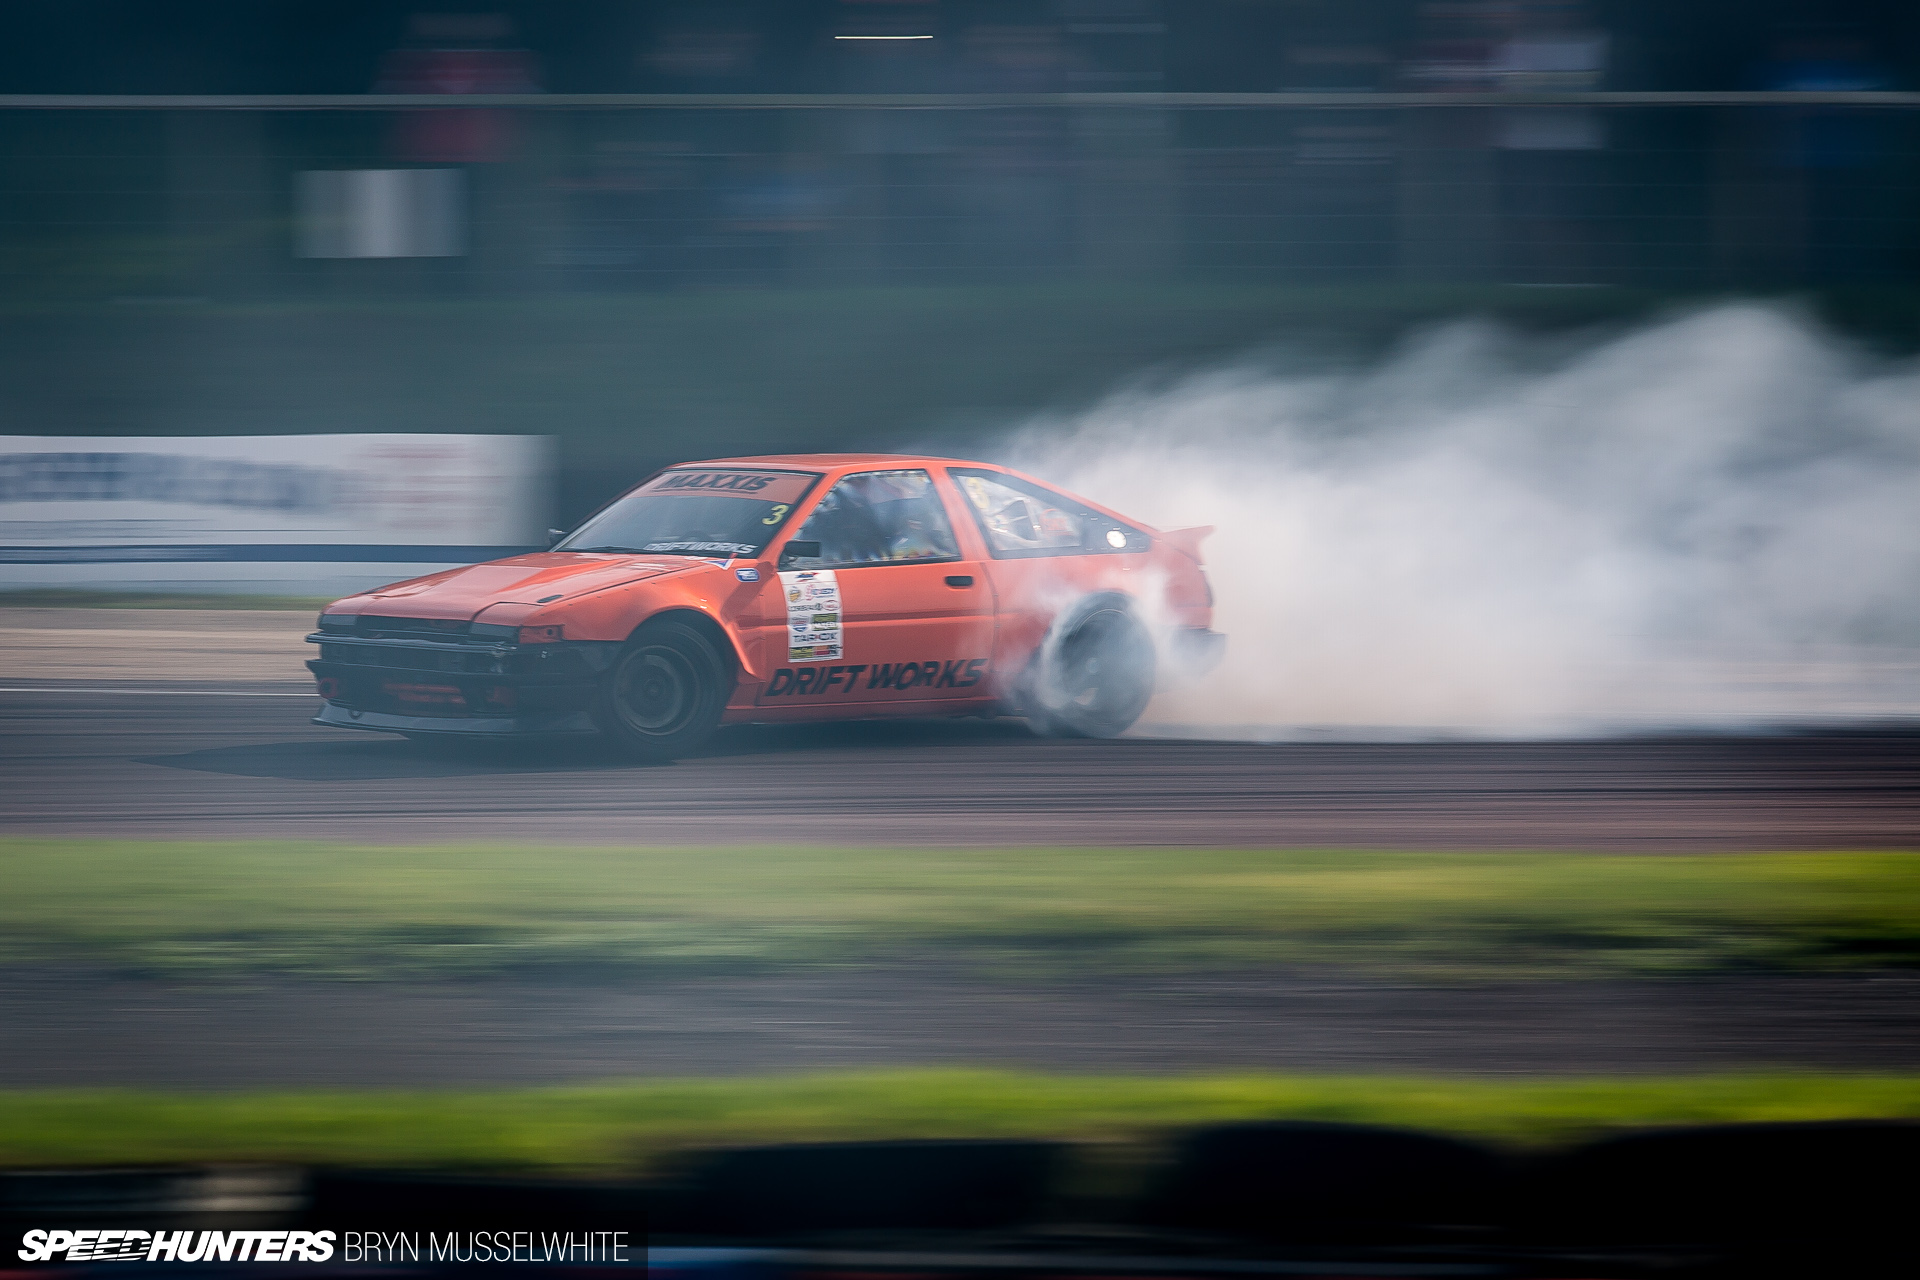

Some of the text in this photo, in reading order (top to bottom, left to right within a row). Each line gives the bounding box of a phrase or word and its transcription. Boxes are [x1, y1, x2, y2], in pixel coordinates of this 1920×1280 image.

[656, 473, 776, 491] MAXXIS
[762, 504, 789, 525] 3
[643, 542, 758, 554] DRIFTWORKS
